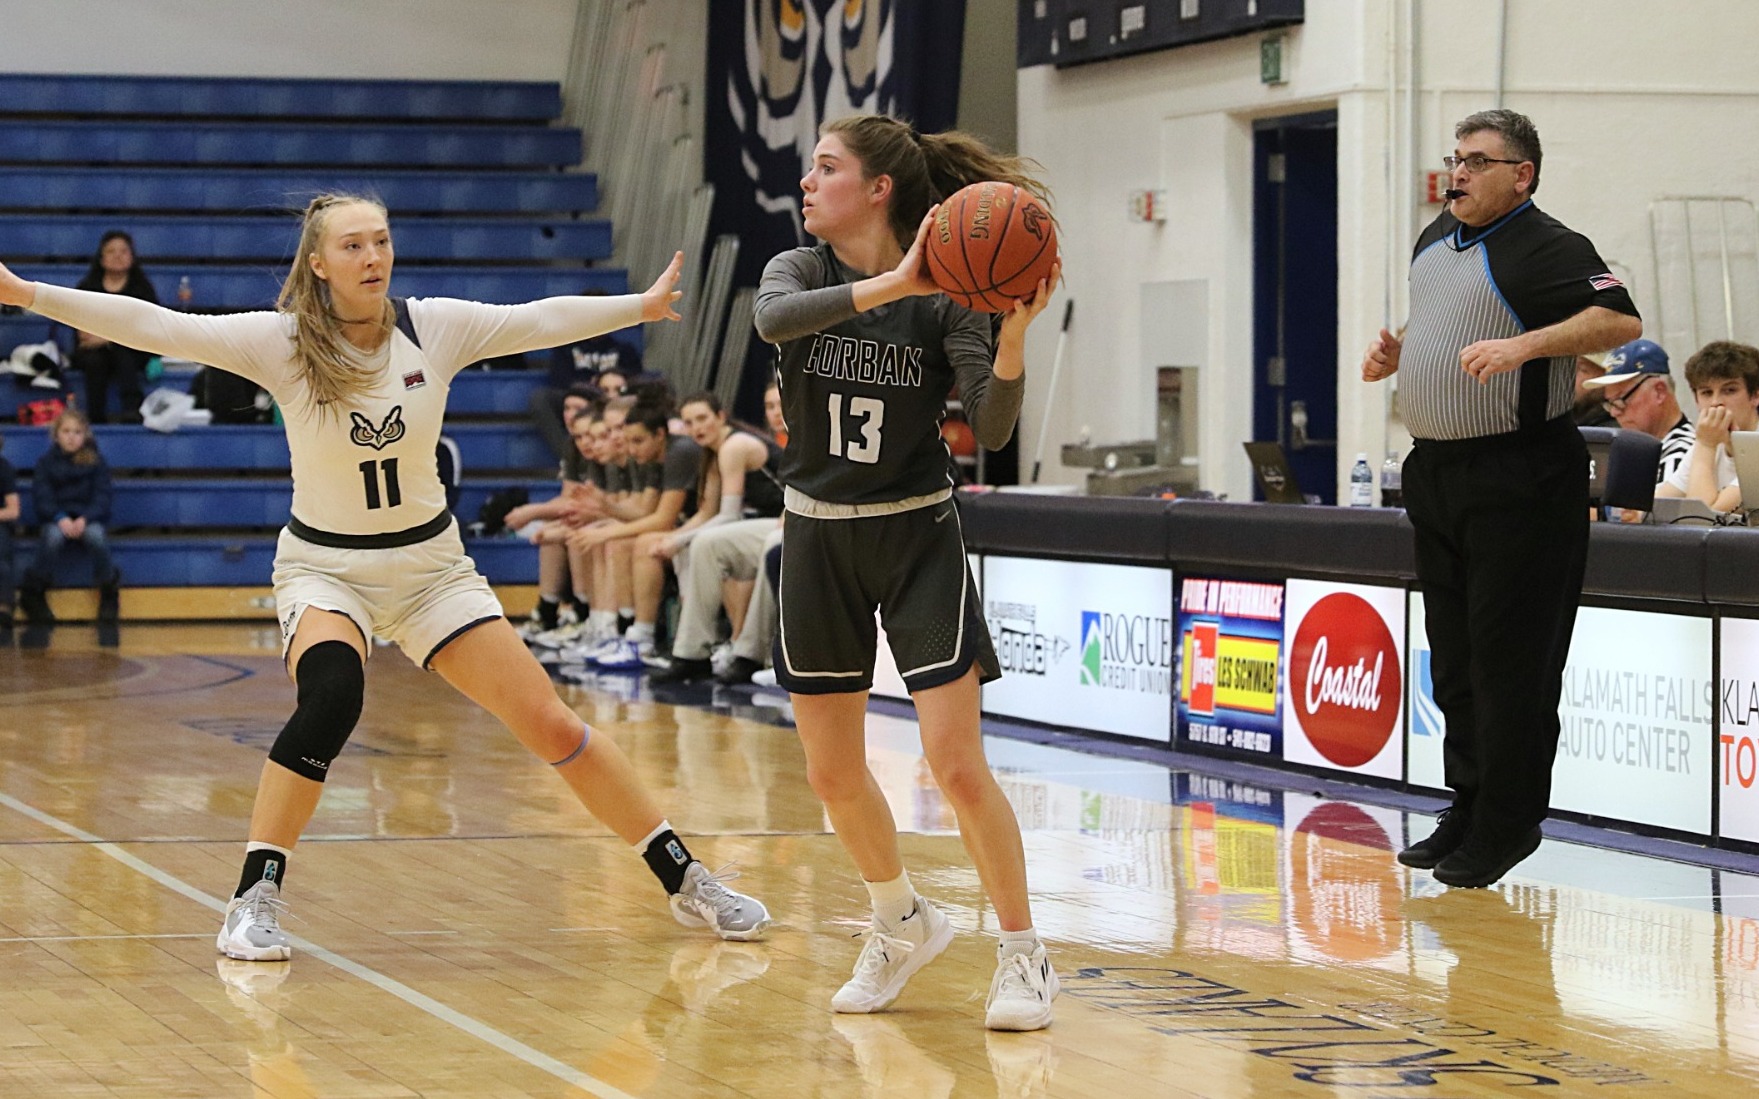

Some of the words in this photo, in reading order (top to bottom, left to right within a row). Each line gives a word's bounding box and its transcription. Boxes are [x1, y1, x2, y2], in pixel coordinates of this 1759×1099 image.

[828, 393, 885, 465] 13
[359, 457, 402, 510] 11
[1103, 612, 1170, 669] ROGUE
[1102, 664, 1136, 691] CREDIT
[1140, 668, 1170, 696] UNION
[1217, 655, 1233, 689] LES
[1234, 657, 1275, 694] SCHWAB
[1306, 635, 1384, 715] Coastal
[1562, 665, 1648, 717] KLAMATH
[1655, 675, 1713, 726] FALLS
[1558, 714, 1606, 762] AUTO
[1612, 720, 1691, 775] CENTER
[1720, 734, 1759, 789] TO
